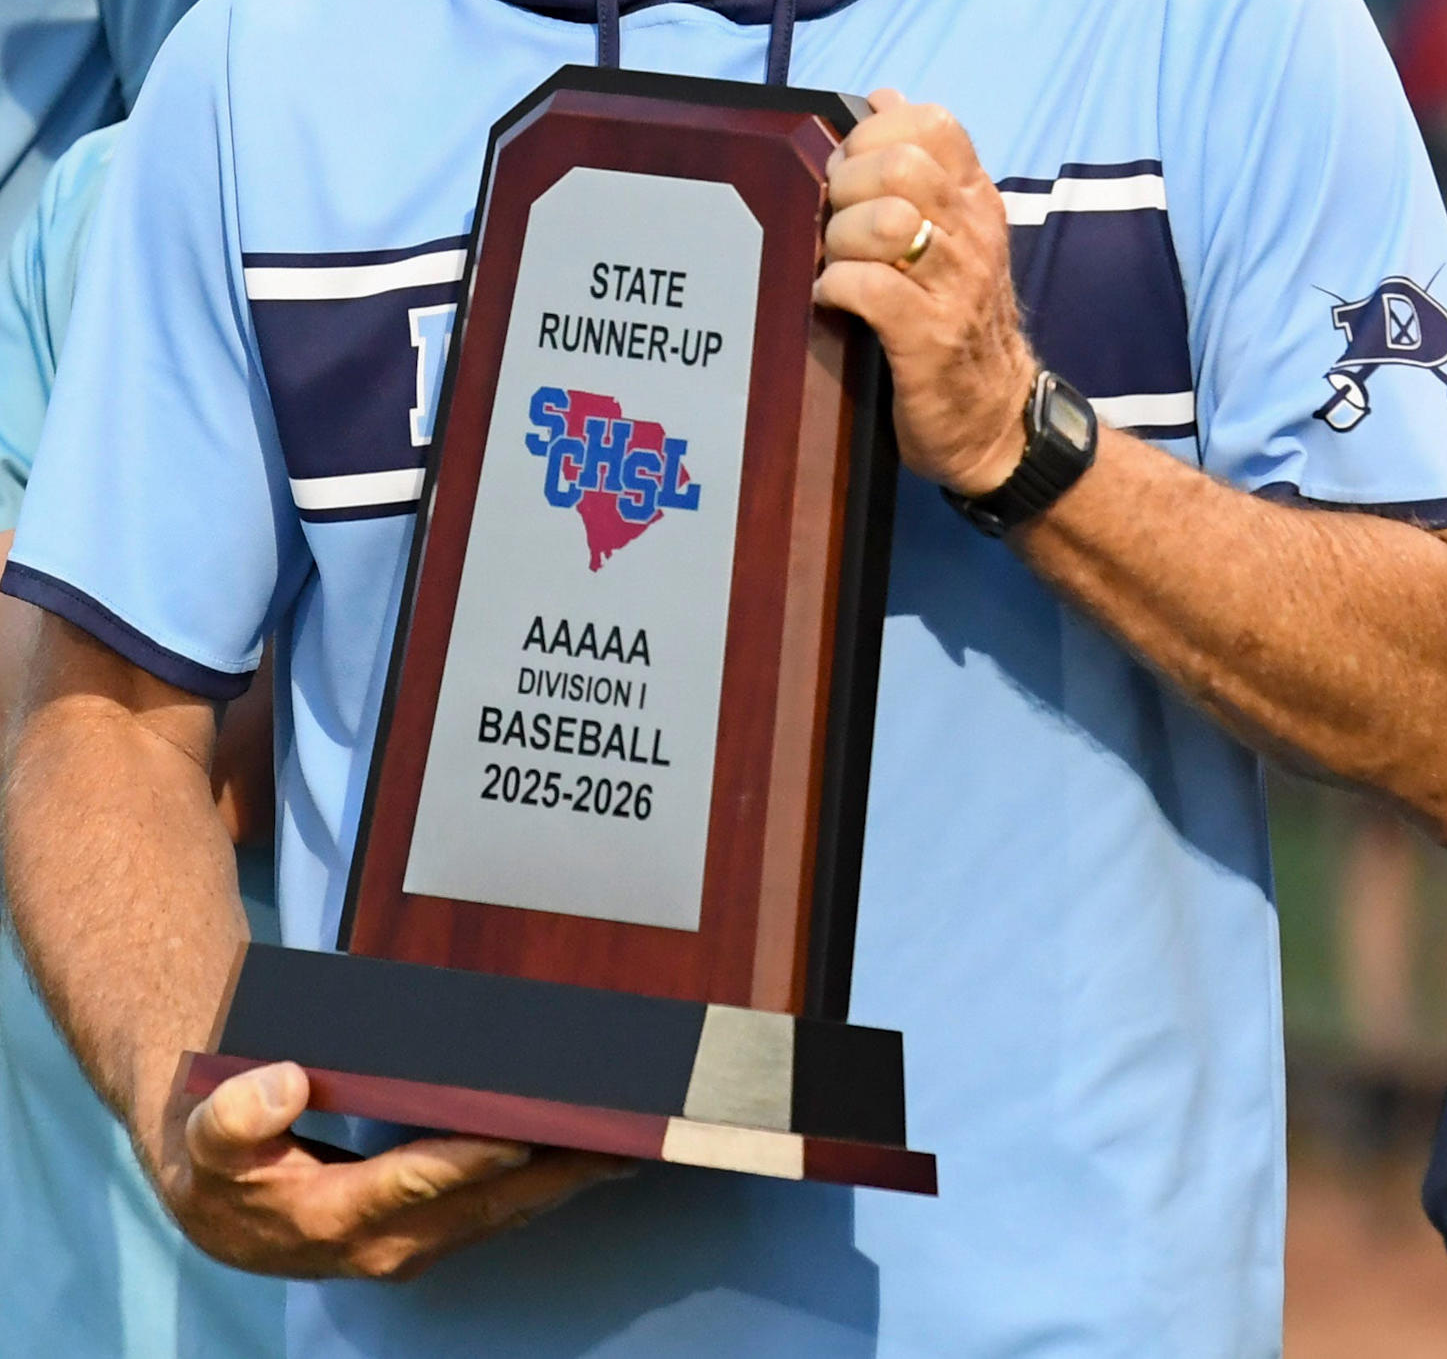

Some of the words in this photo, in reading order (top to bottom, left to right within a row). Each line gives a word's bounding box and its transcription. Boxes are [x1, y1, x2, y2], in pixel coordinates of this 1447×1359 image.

[590, 262, 687, 309] STATE
[538, 313, 722, 368] RUNNER-UP
[525, 386, 702, 523] SCHSL
[522, 616, 651, 667] AAAAA
[517, 667, 632, 709] DIVISION
[638, 682, 647, 710] I
[478, 706, 671, 767] BASEBALL
[480, 763, 653, 821] 2025-2026
